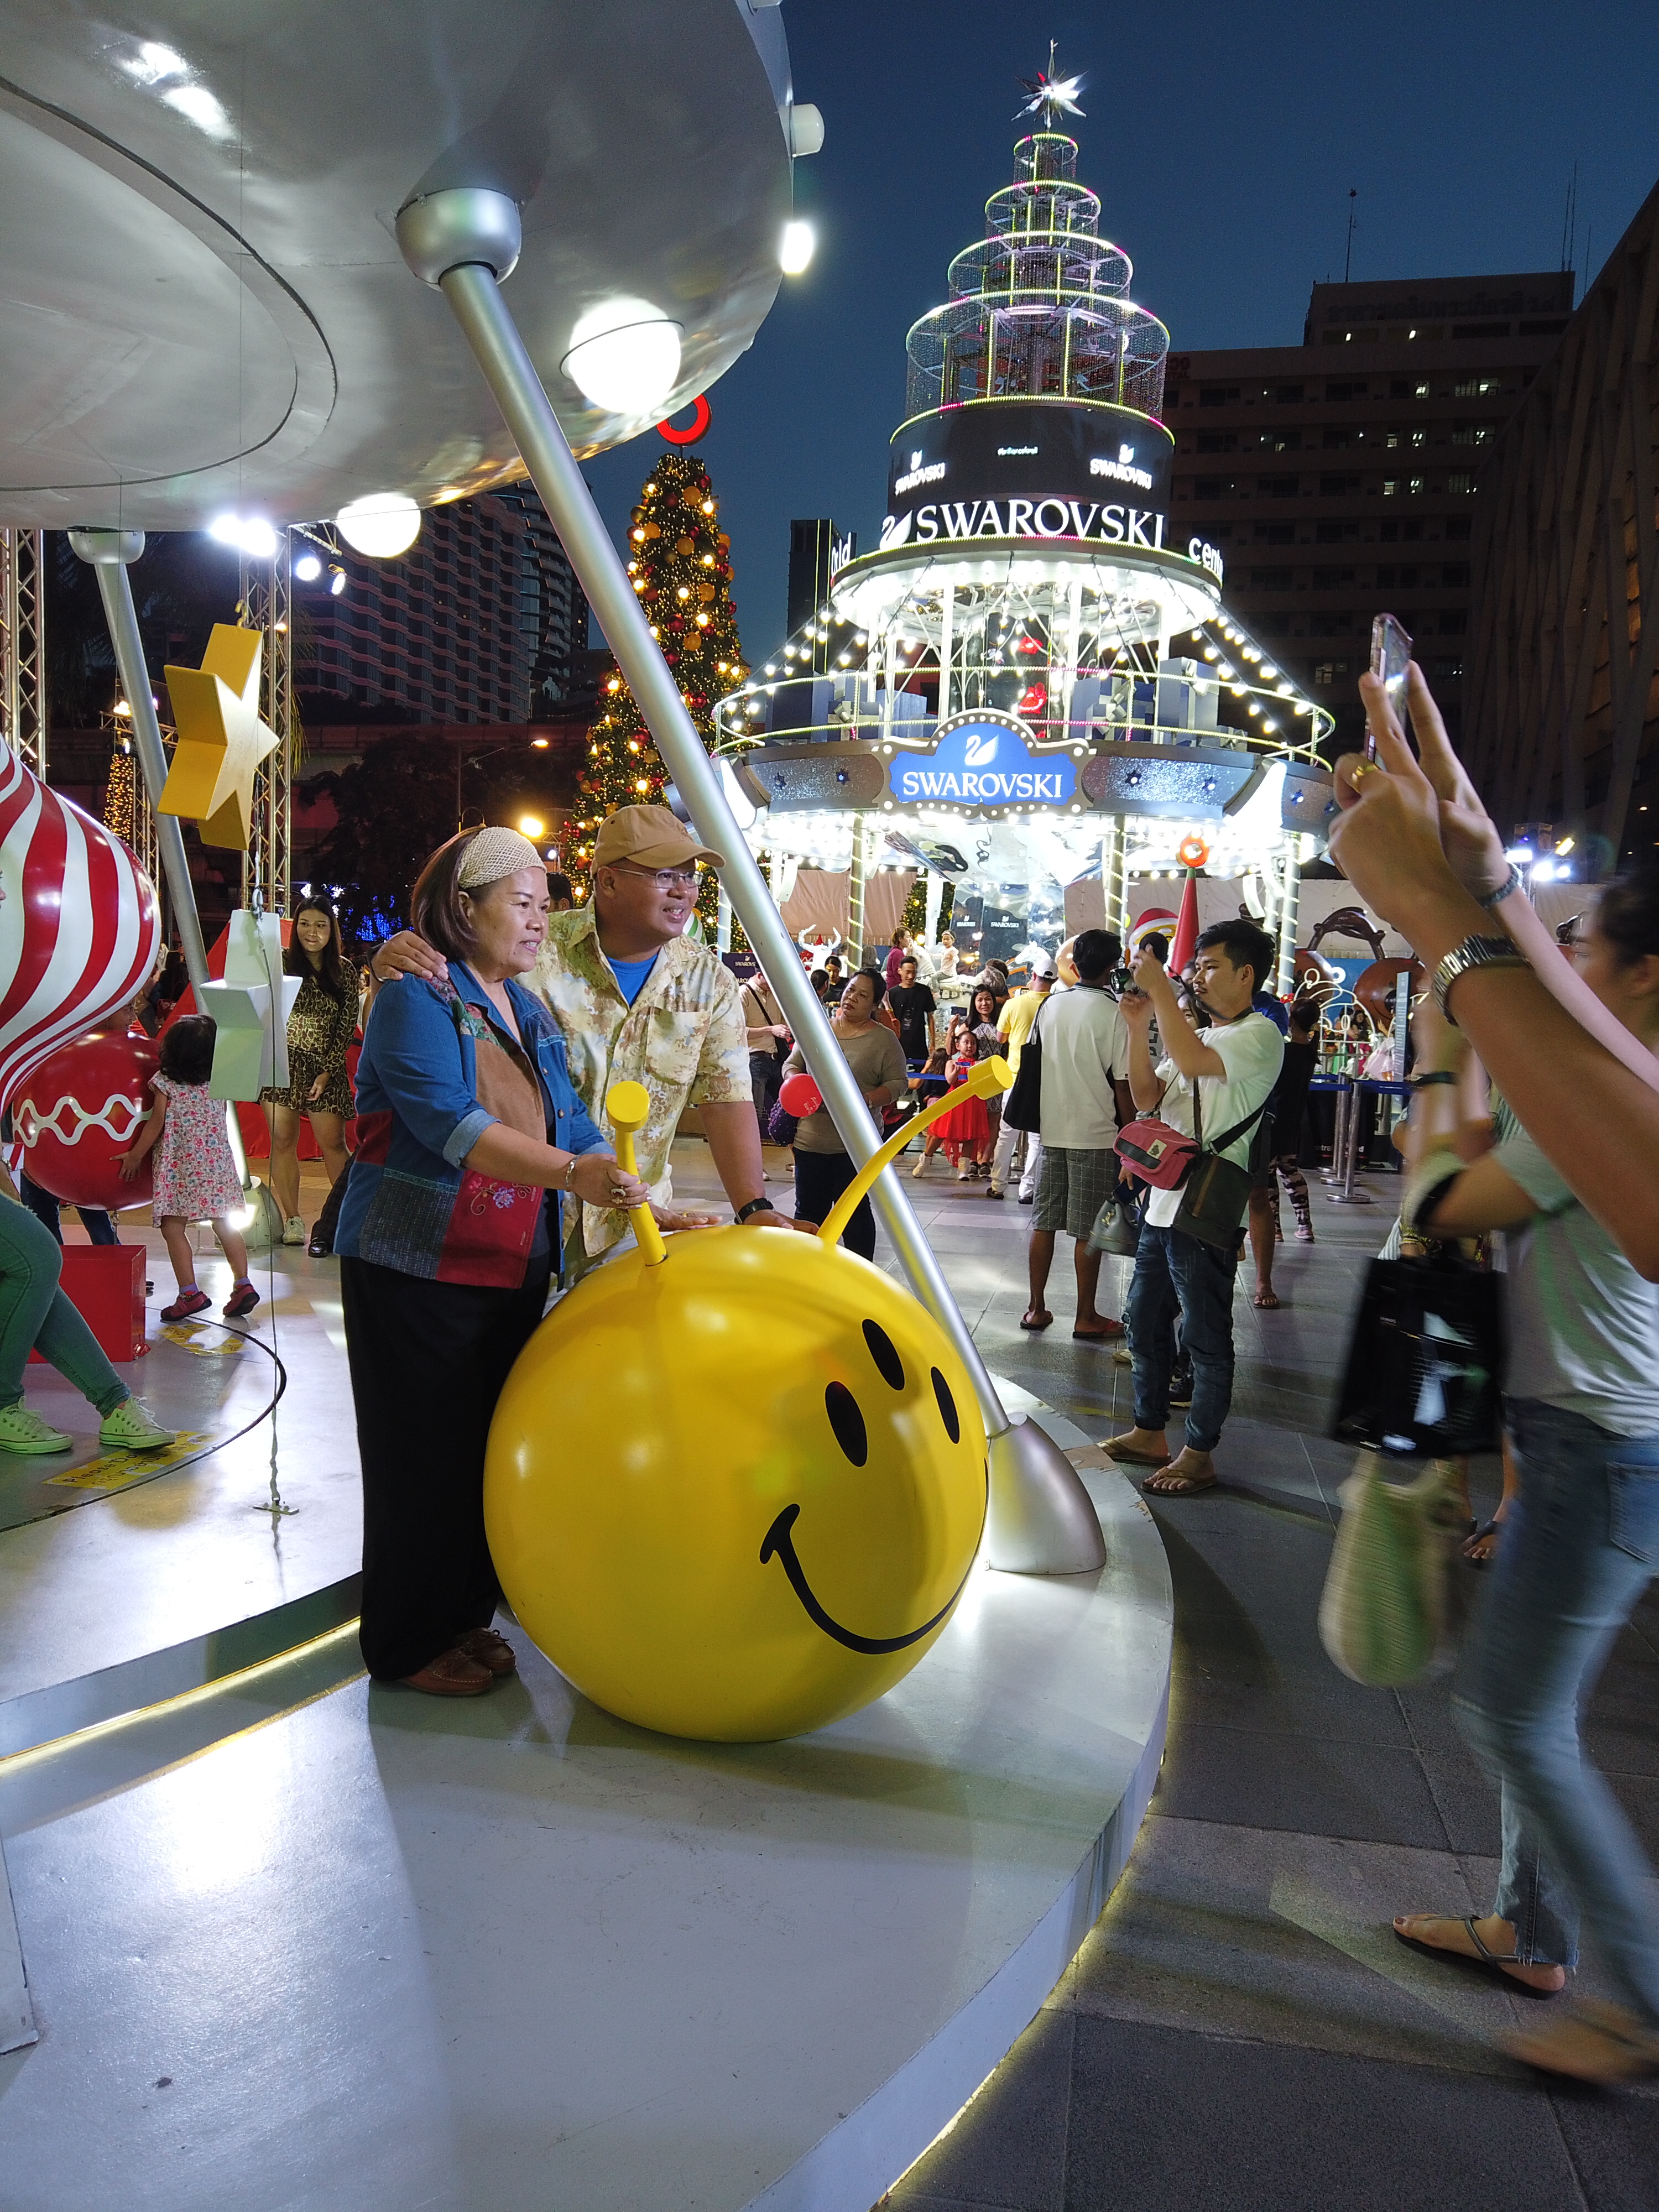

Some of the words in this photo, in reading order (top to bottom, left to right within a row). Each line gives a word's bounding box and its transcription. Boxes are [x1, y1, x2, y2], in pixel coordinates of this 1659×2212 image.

[895, 462, 946, 497] SWAROVSKI
[1090, 458, 1152, 490] SWAROVSKI
[916, 499, 1165, 550] SWAROVSKI
[902, 772, 1062, 799] SWAROVSKI
